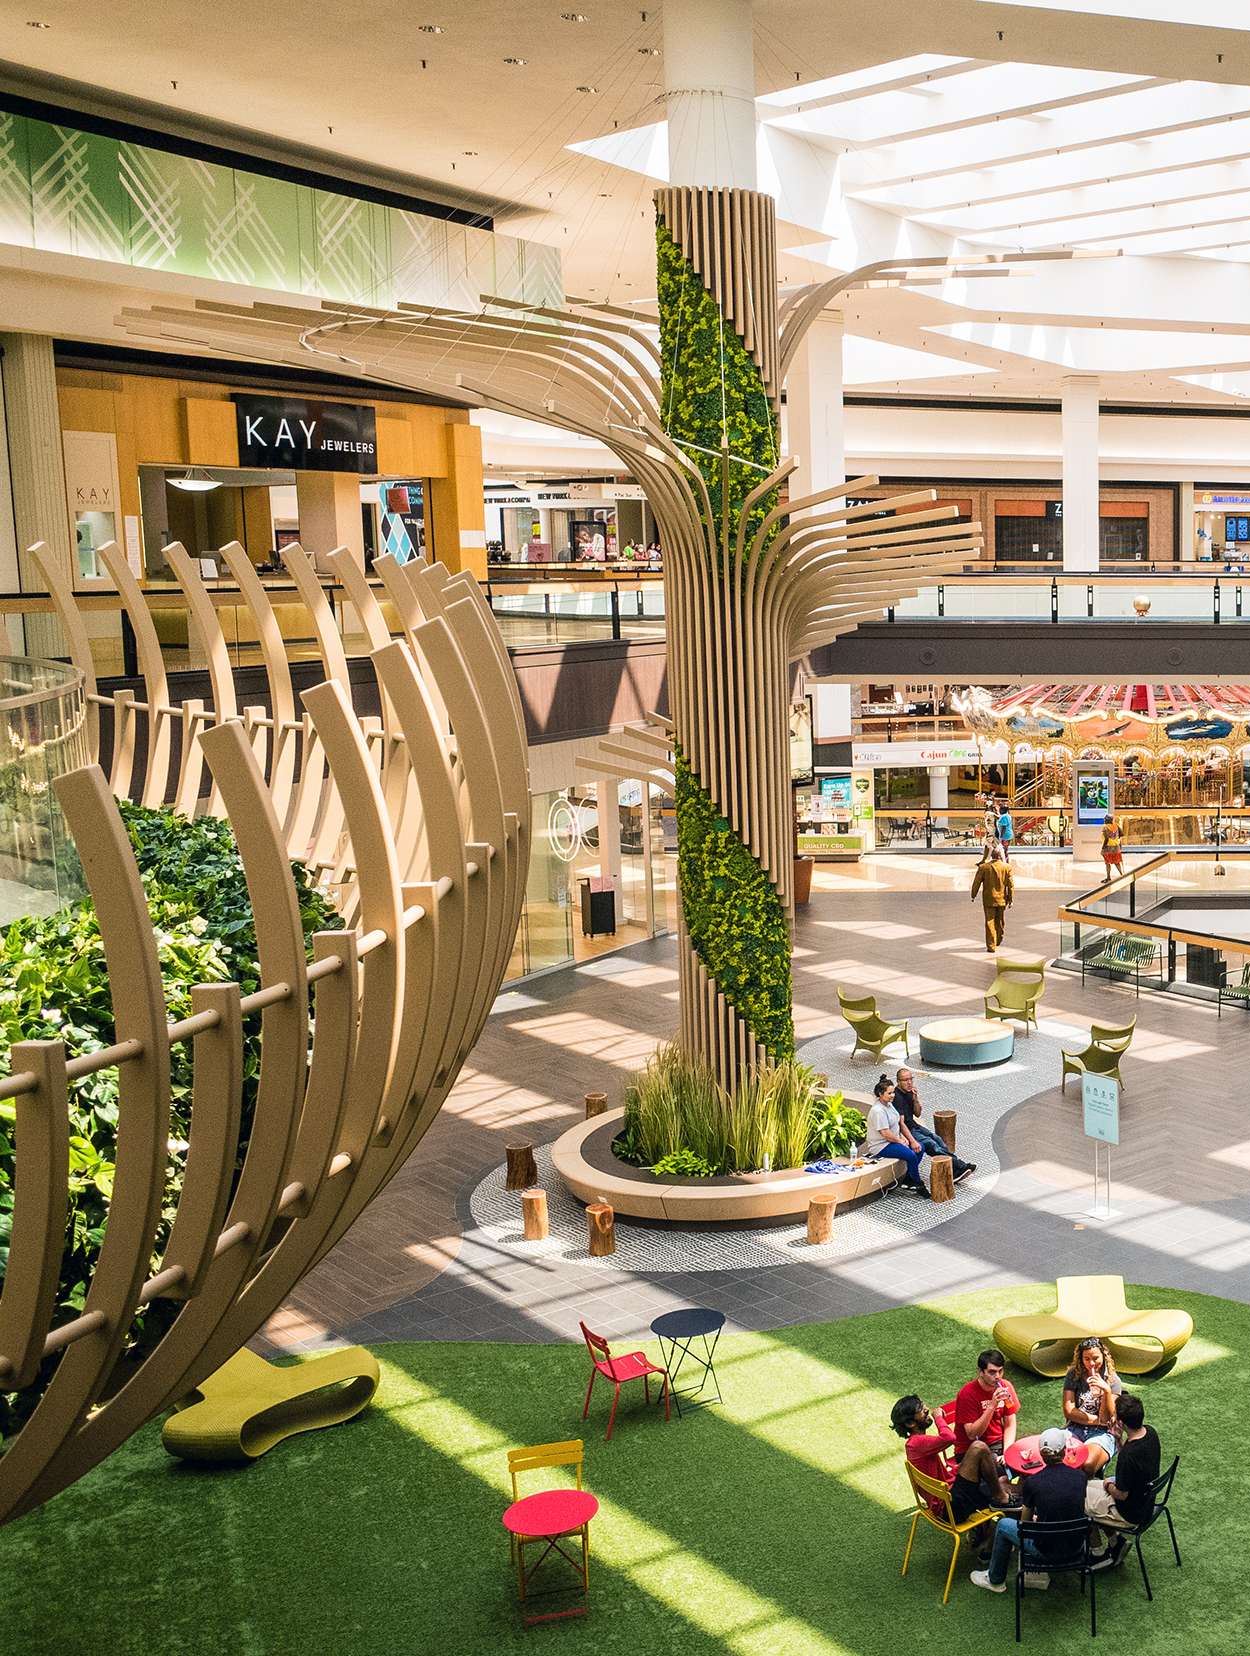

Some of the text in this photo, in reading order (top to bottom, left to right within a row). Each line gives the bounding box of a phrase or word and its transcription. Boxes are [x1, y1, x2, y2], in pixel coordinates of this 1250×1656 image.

[245, 415, 375, 455] KAY JEWELERS
[76, 487, 110, 500] KAY
[920, 751, 948, 761] Cajun
